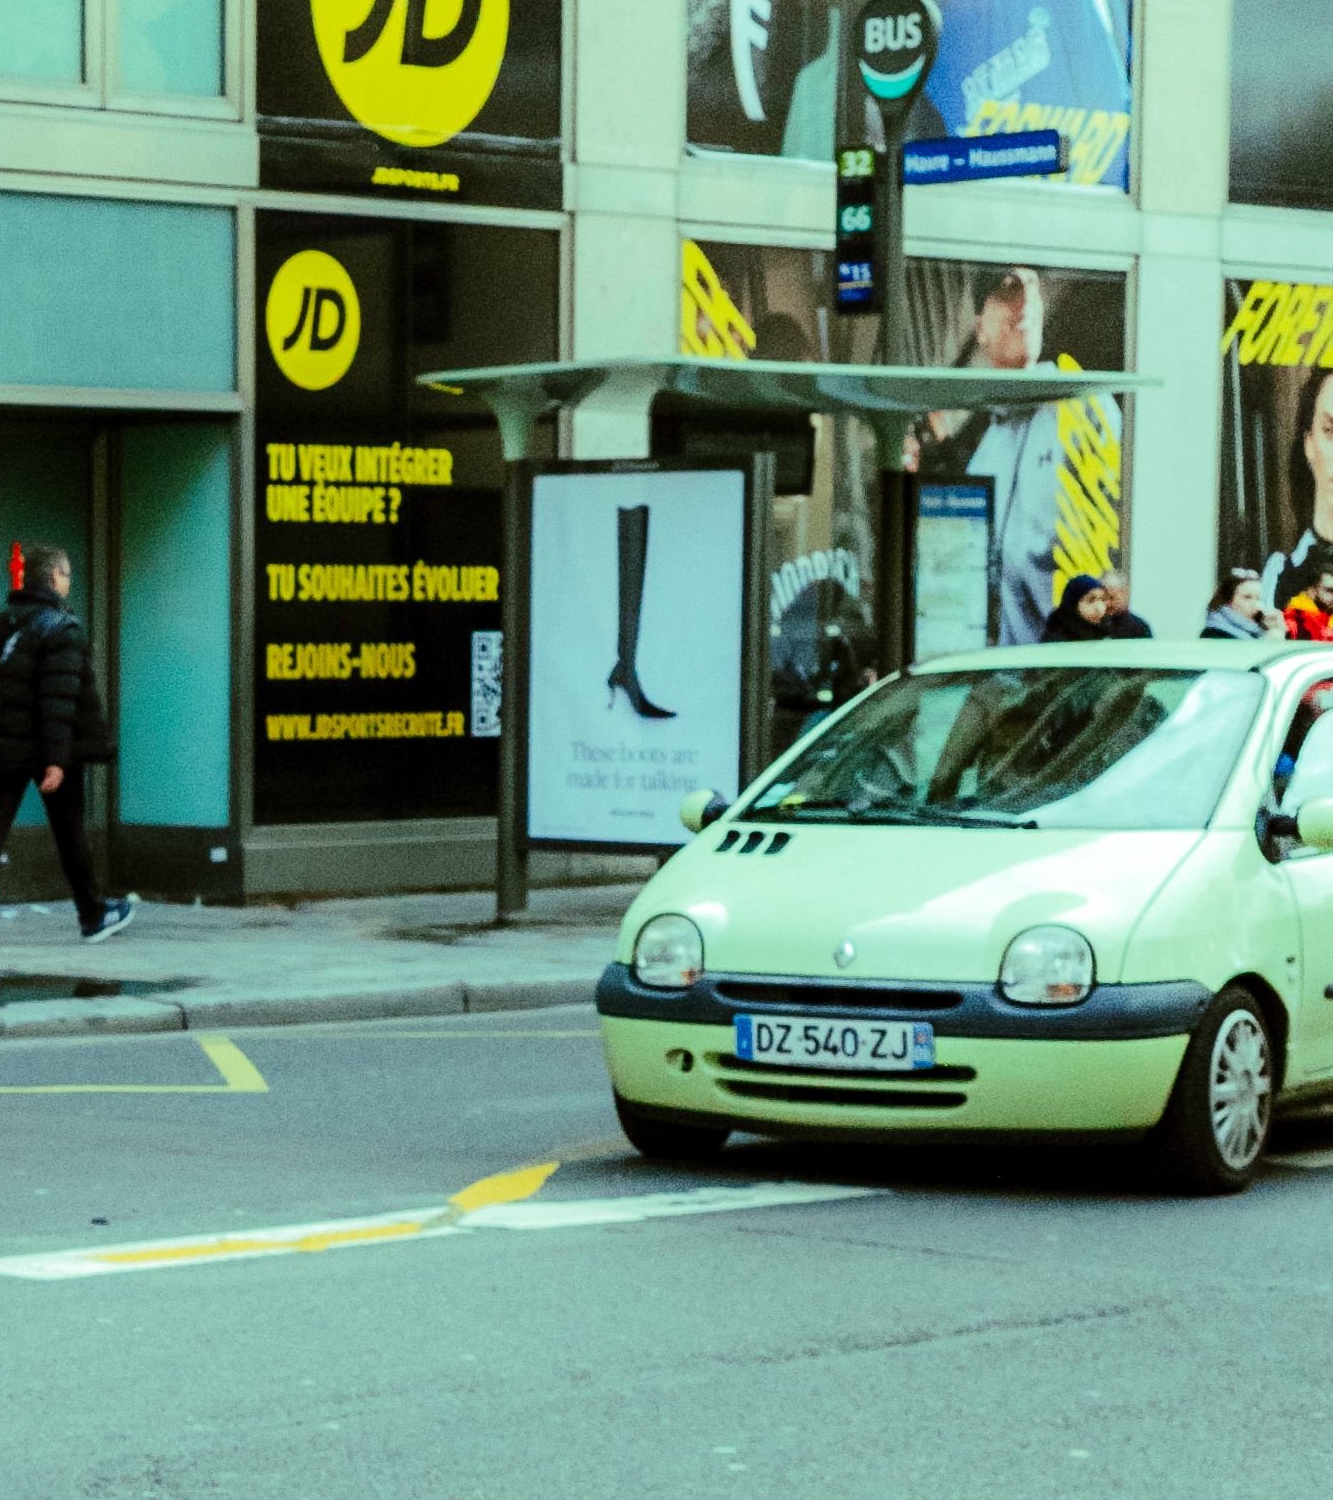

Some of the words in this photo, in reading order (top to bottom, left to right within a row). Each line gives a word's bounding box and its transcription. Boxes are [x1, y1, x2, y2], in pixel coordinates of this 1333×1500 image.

[863, 11, 923, 54] BUS
[839, 149, 875, 177] 32
[840, 204, 873, 233] 66
[282, 286, 348, 352] JD
[266, 443, 296, 481] TU
[297, 444, 353, 482] VEUX
[355, 440, 454, 486] INTÉGRER
[266, 484, 310, 522] UNE
[312, 482, 386, 523] ÉQUIPE
[266, 563, 296, 600] TU
[297, 563, 411, 601] SOUHAITES
[412, 558, 500, 601] ÉVOLUER
[266, 641, 417, 680] REJOINS-NOUS
